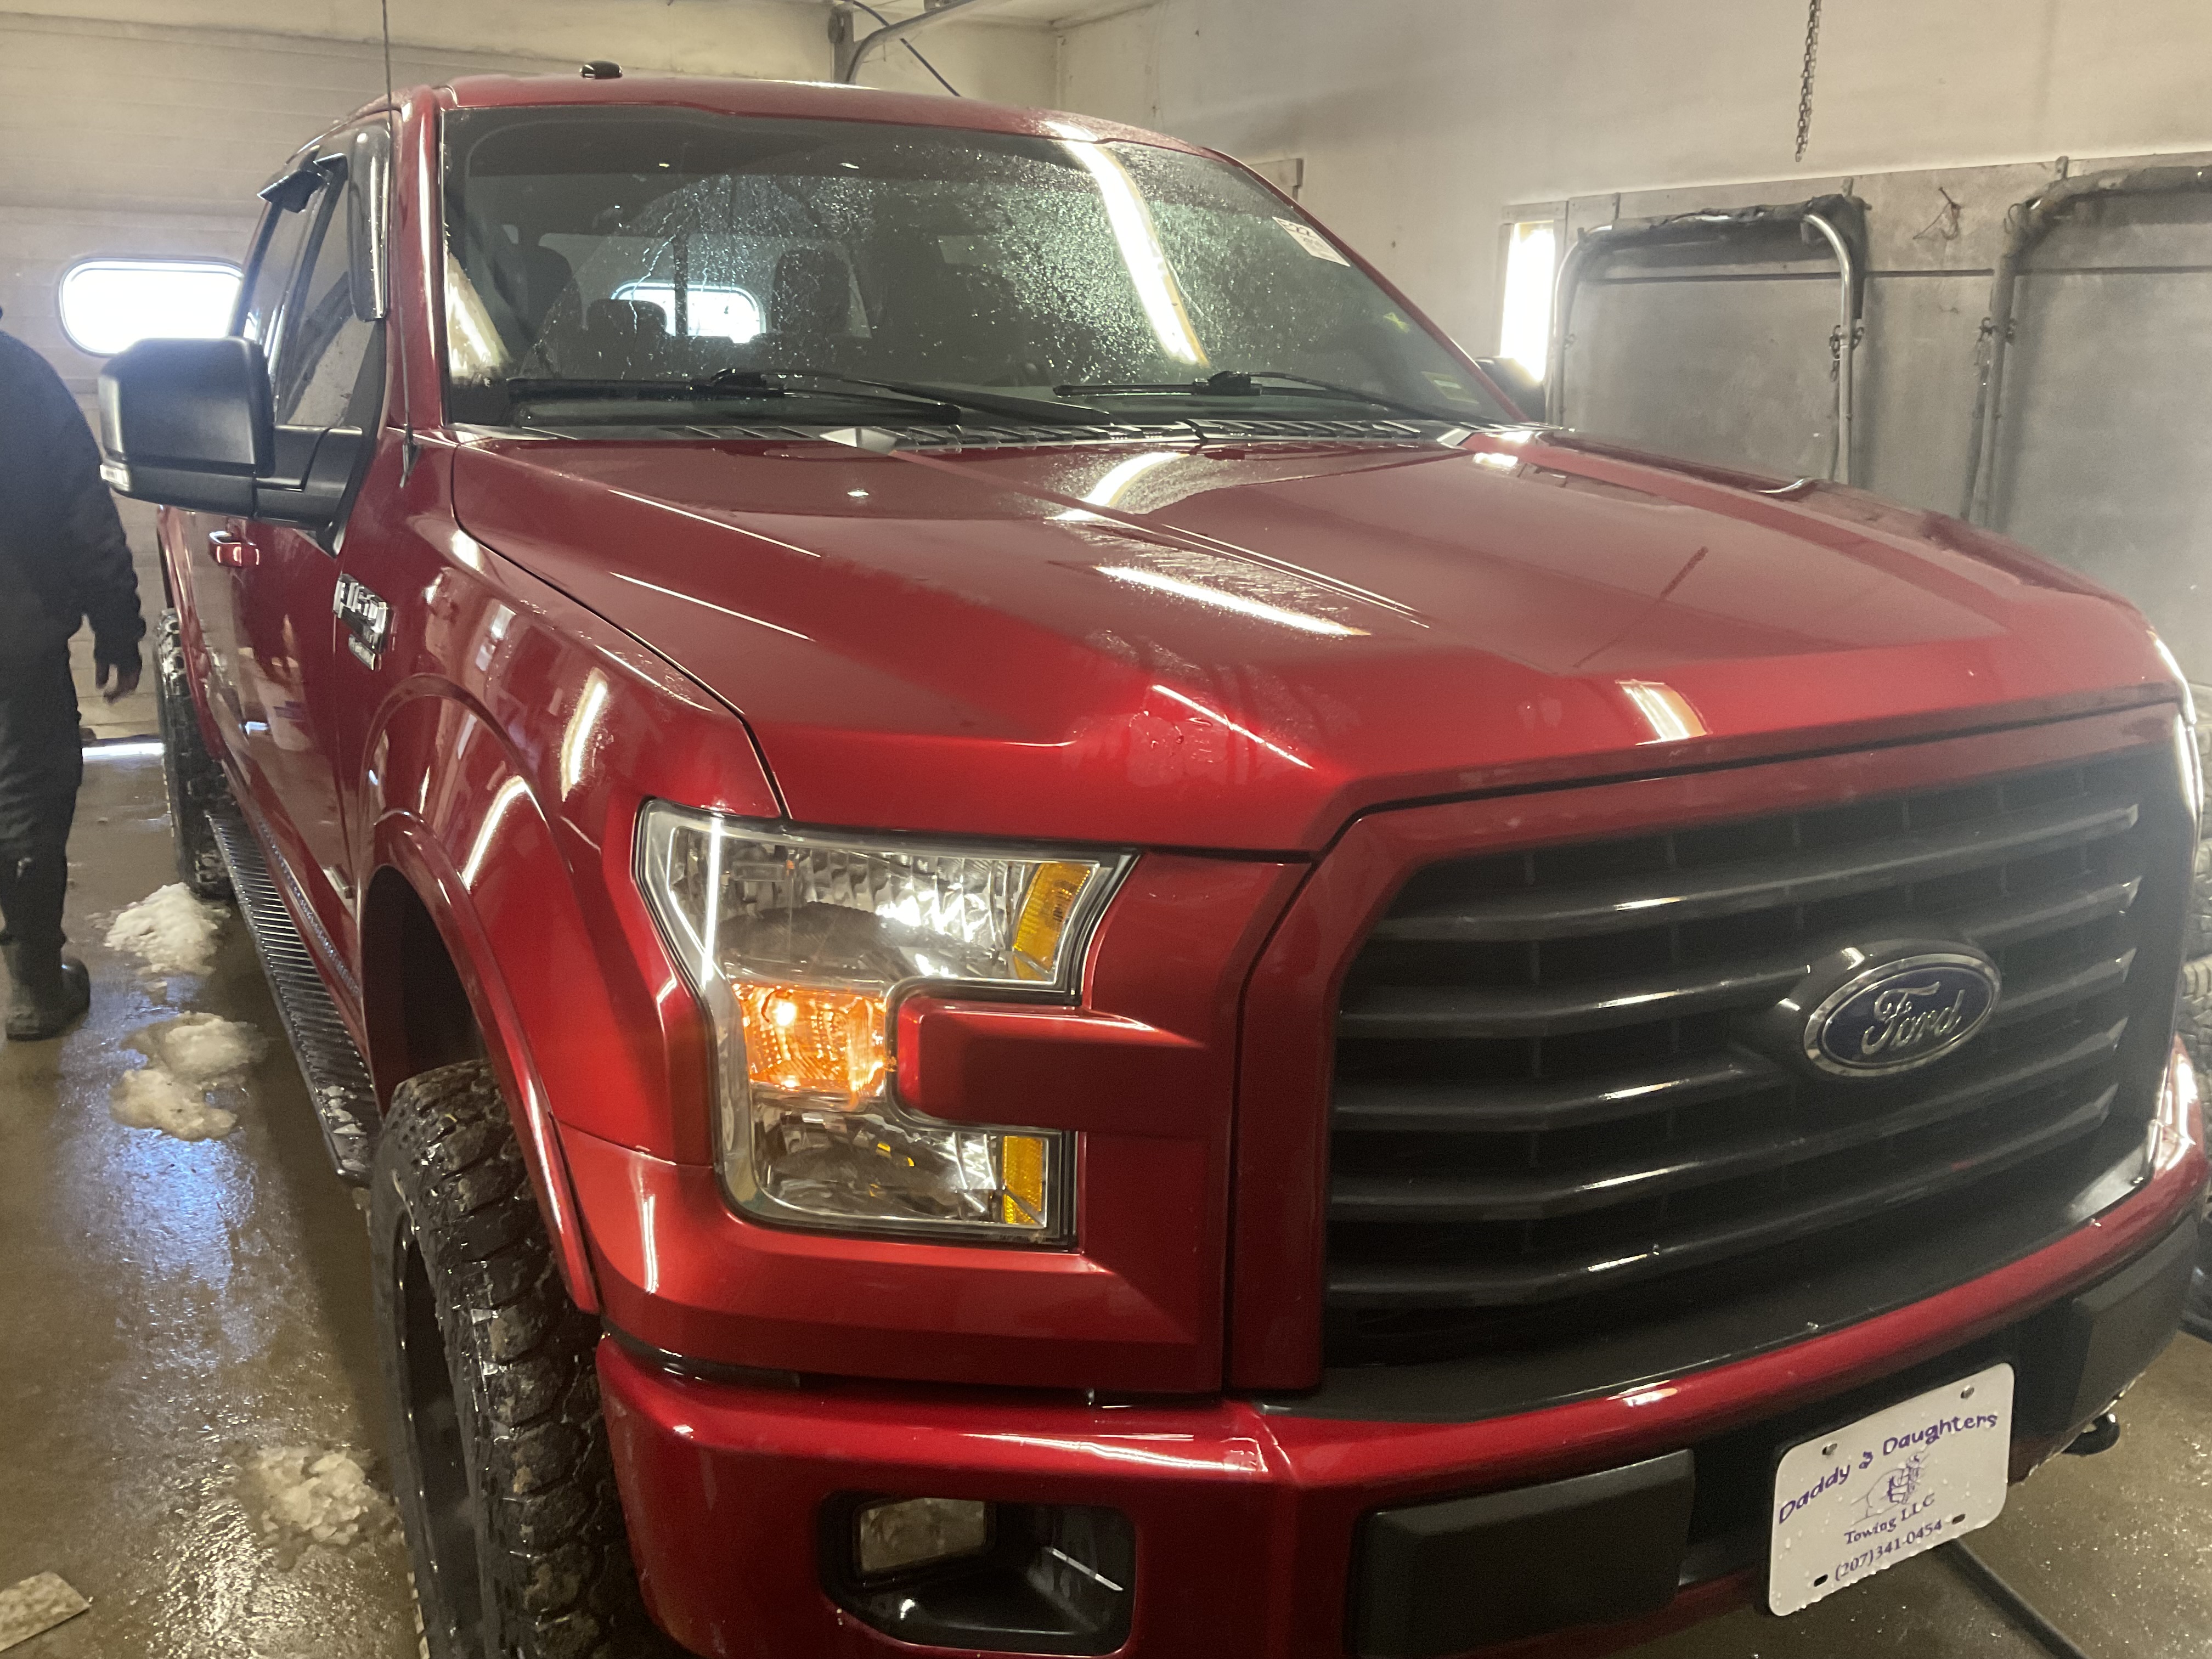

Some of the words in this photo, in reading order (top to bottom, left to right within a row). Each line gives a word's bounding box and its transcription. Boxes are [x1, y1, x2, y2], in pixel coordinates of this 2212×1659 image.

[1861, 981, 1966, 1055] Ford
[1778, 1464, 1851, 1525] Daddy
[1882, 1414, 1998, 1456] Daughters
[1843, 1517, 1897, 1544] Towing
[1901, 1493, 1935, 1521] LLC
